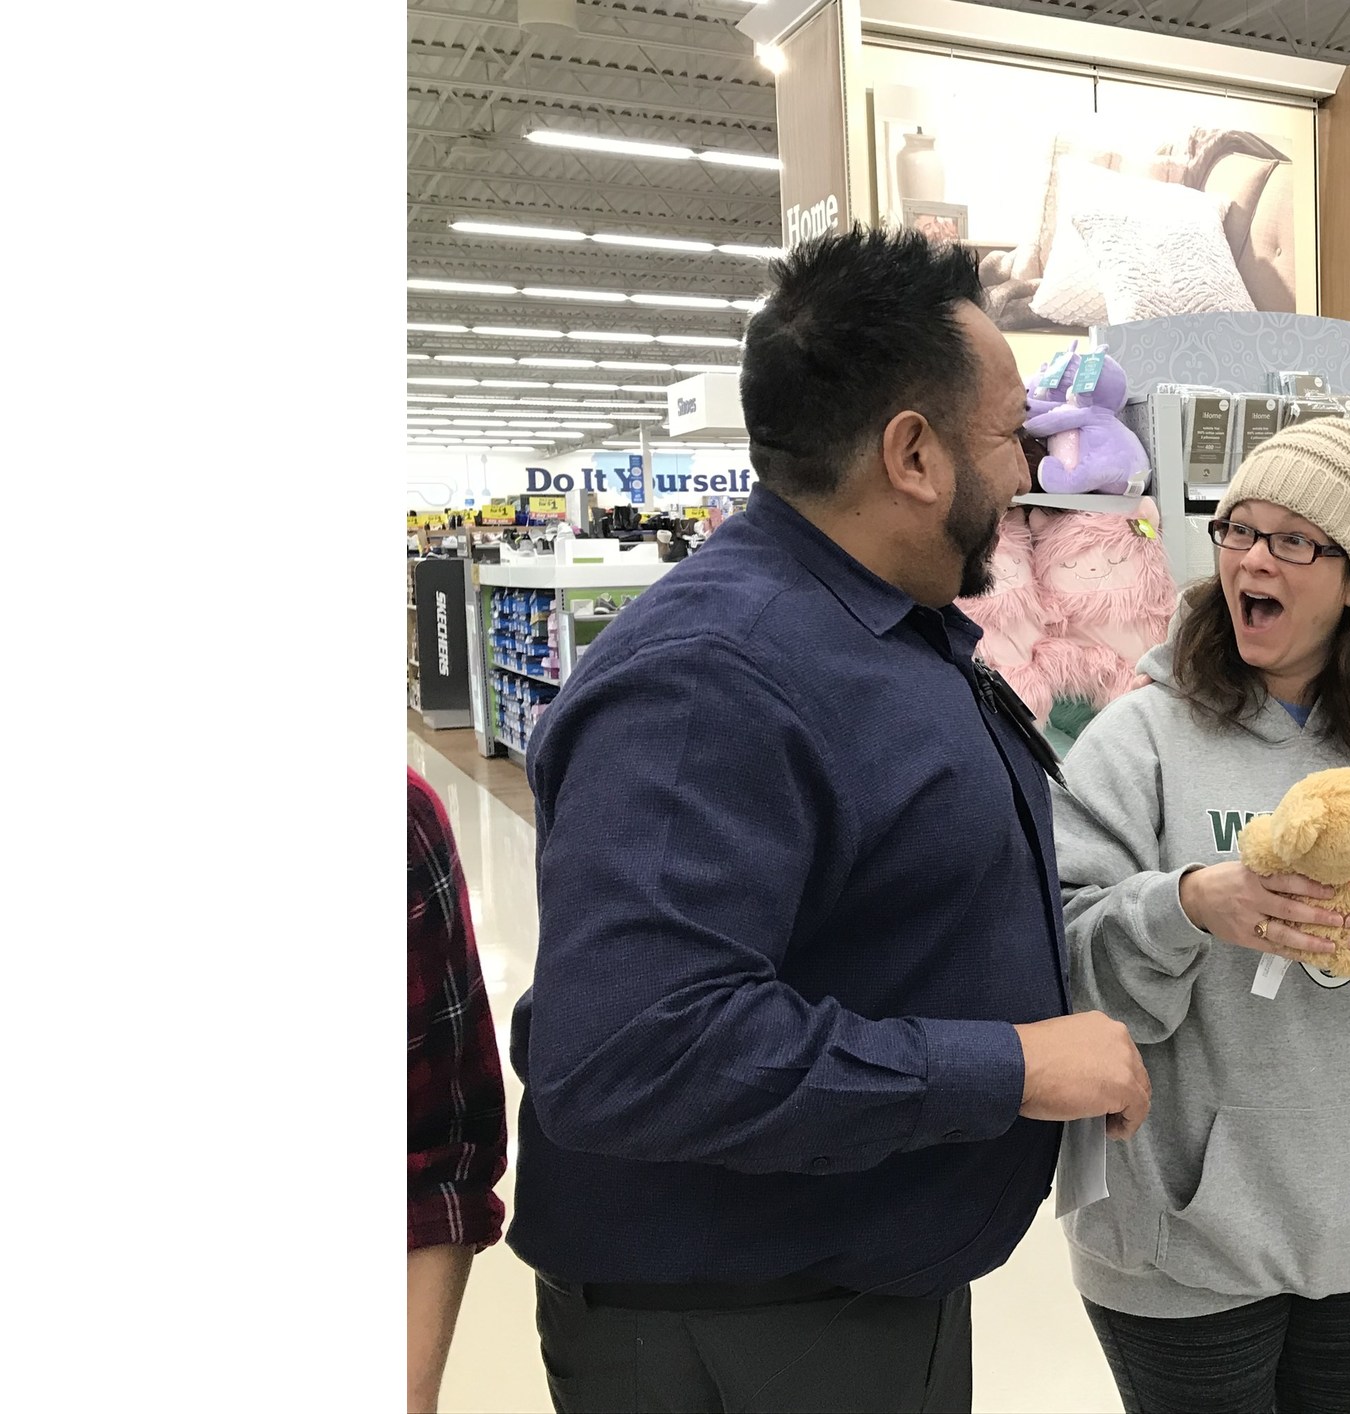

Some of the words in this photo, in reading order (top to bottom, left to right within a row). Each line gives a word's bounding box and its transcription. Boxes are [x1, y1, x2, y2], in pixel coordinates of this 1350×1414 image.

[787, 194, 838, 249] Home
[677, 397, 697, 417] Shoes
[1204, 412, 1222, 420] Home
[1253, 412, 1271, 420] Home
[525, 467, 574, 493] Do
[582, 468, 606, 492] It
[613, 468, 750, 493] Yurself
[435, 590, 449, 677] SKECHERS
